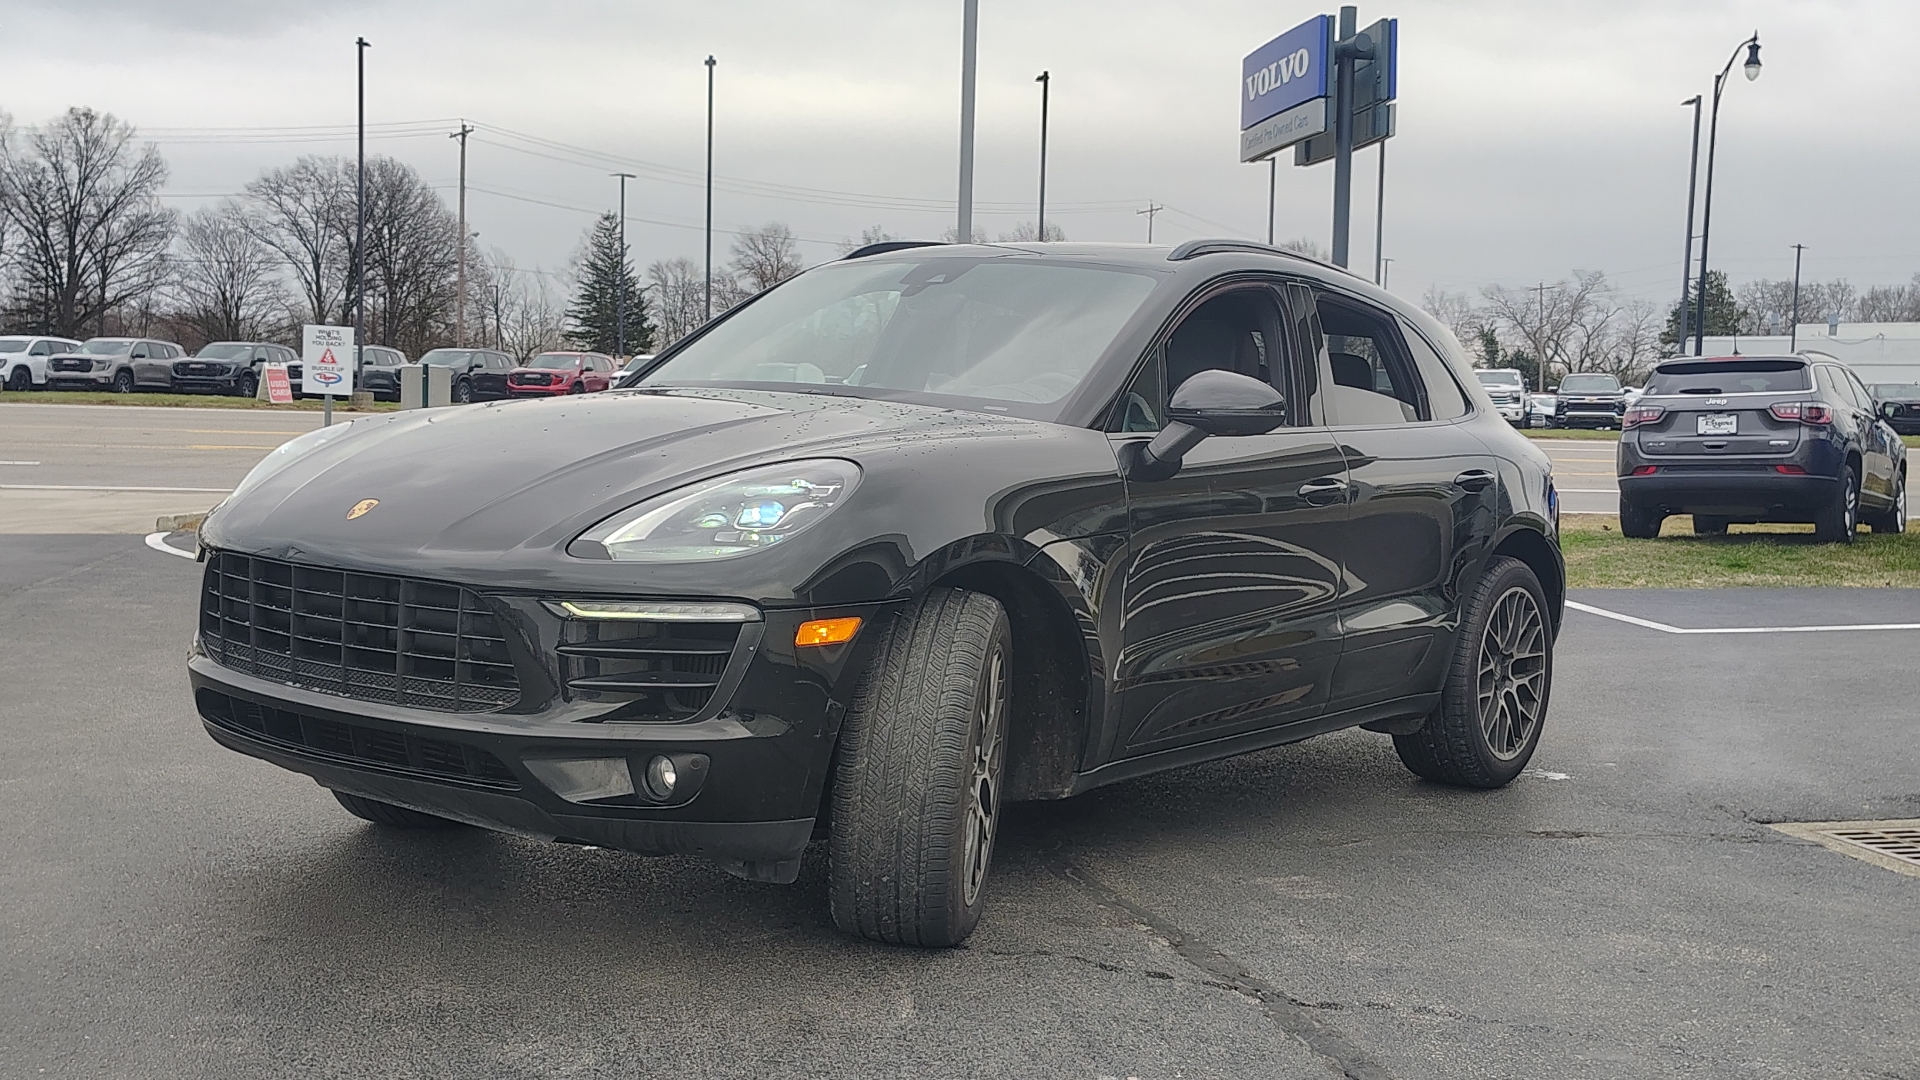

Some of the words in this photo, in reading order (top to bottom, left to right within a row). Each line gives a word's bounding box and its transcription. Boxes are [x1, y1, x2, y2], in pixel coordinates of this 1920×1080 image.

[1246, 48, 1309, 101] VOLVO
[1273, 117, 1293, 138] Owned
[1294, 114, 1309, 130] Cars
[1705, 397, 1728, 406] Jeep
